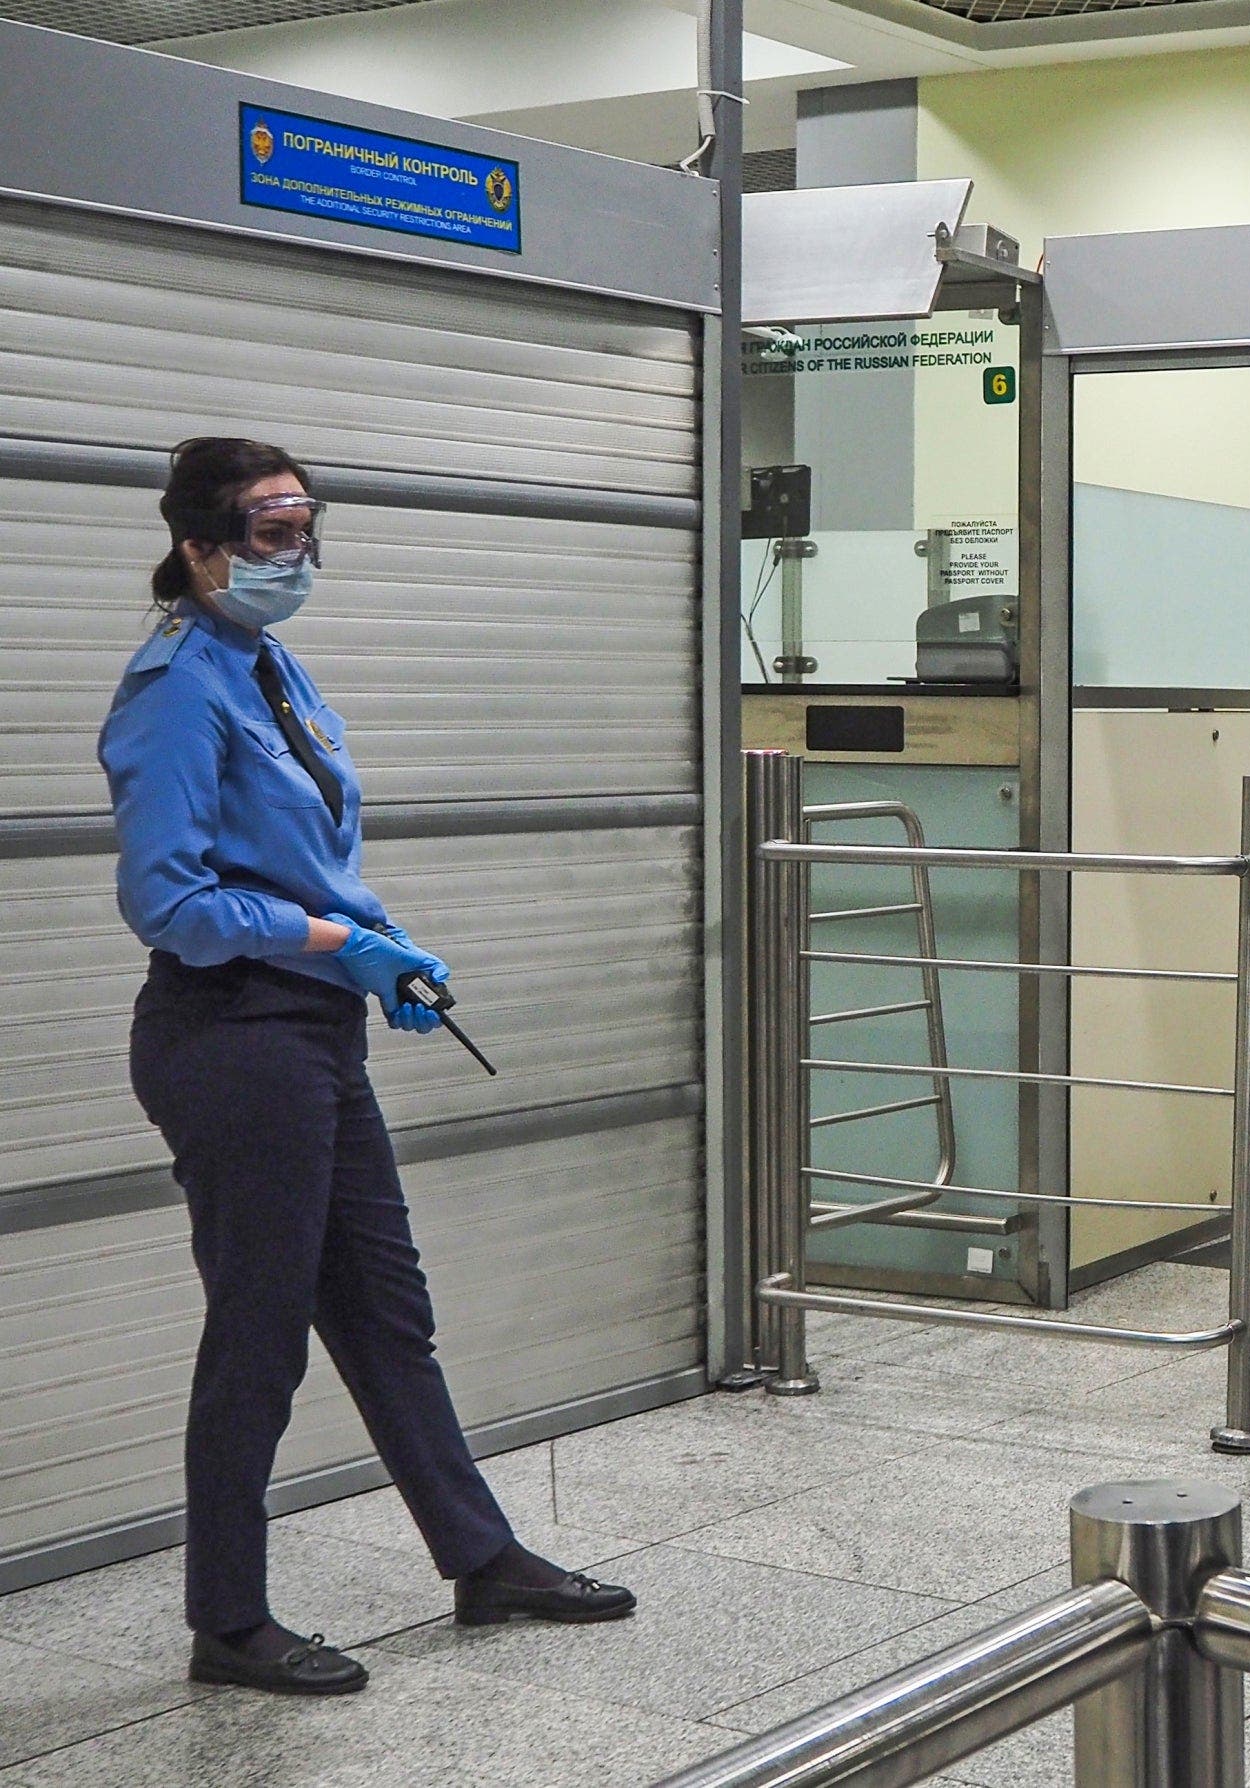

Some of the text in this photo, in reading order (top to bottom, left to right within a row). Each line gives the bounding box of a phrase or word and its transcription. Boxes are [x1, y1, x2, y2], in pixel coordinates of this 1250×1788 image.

[283, 132, 478, 186] ПОГРАНИЧНЫЙ КОНТРОЛЬ
[350, 164, 417, 186] BORDER CONTROL
[250, 172, 280, 188] ЗОНА
[282, 178, 383, 206] ДОПОЛНИТЕЛЬНЫХ
[385, 197, 443, 218] РЕЖИМНЫХ
[300, 194, 472, 234] THE ADDITIONAL SECURITY RESTRICTIONS AREA
[814, 332, 907, 351] РОССИЙСКОЙ
[910, 330, 994, 348] ФЕДЕРАЦИИ
[807, 359, 824, 371] OF
[827, 358, 851, 371] THE
[854, 355, 909, 369] RUSSIAN
[912, 352, 992, 367] FEDERATION
[992, 374, 1007, 396] 6
[951, 520, 997, 528] ПОЖАЛУЙСТА
[982, 528, 1013, 536] ПАСПОРТ
[940, 569, 975, 577] PASSPORT
[944, 577, 1004, 585] PASSPORT COVER
